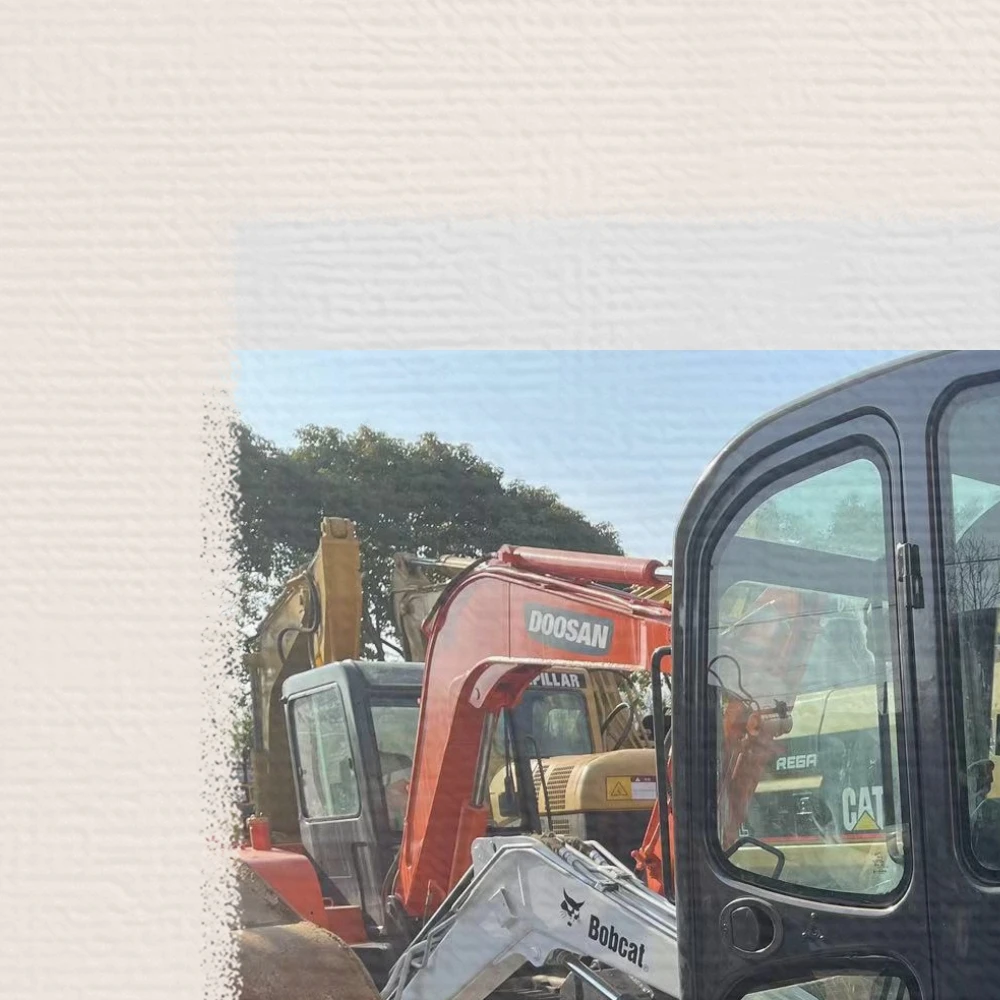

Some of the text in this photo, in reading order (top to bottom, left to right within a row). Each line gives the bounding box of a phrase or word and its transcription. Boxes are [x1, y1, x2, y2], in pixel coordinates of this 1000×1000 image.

[528, 610, 609, 649] DOOSAN
[529, 672, 580, 687] PILLAR
[842, 785, 884, 831] CAT
[588, 914, 646, 968] Bobcat
